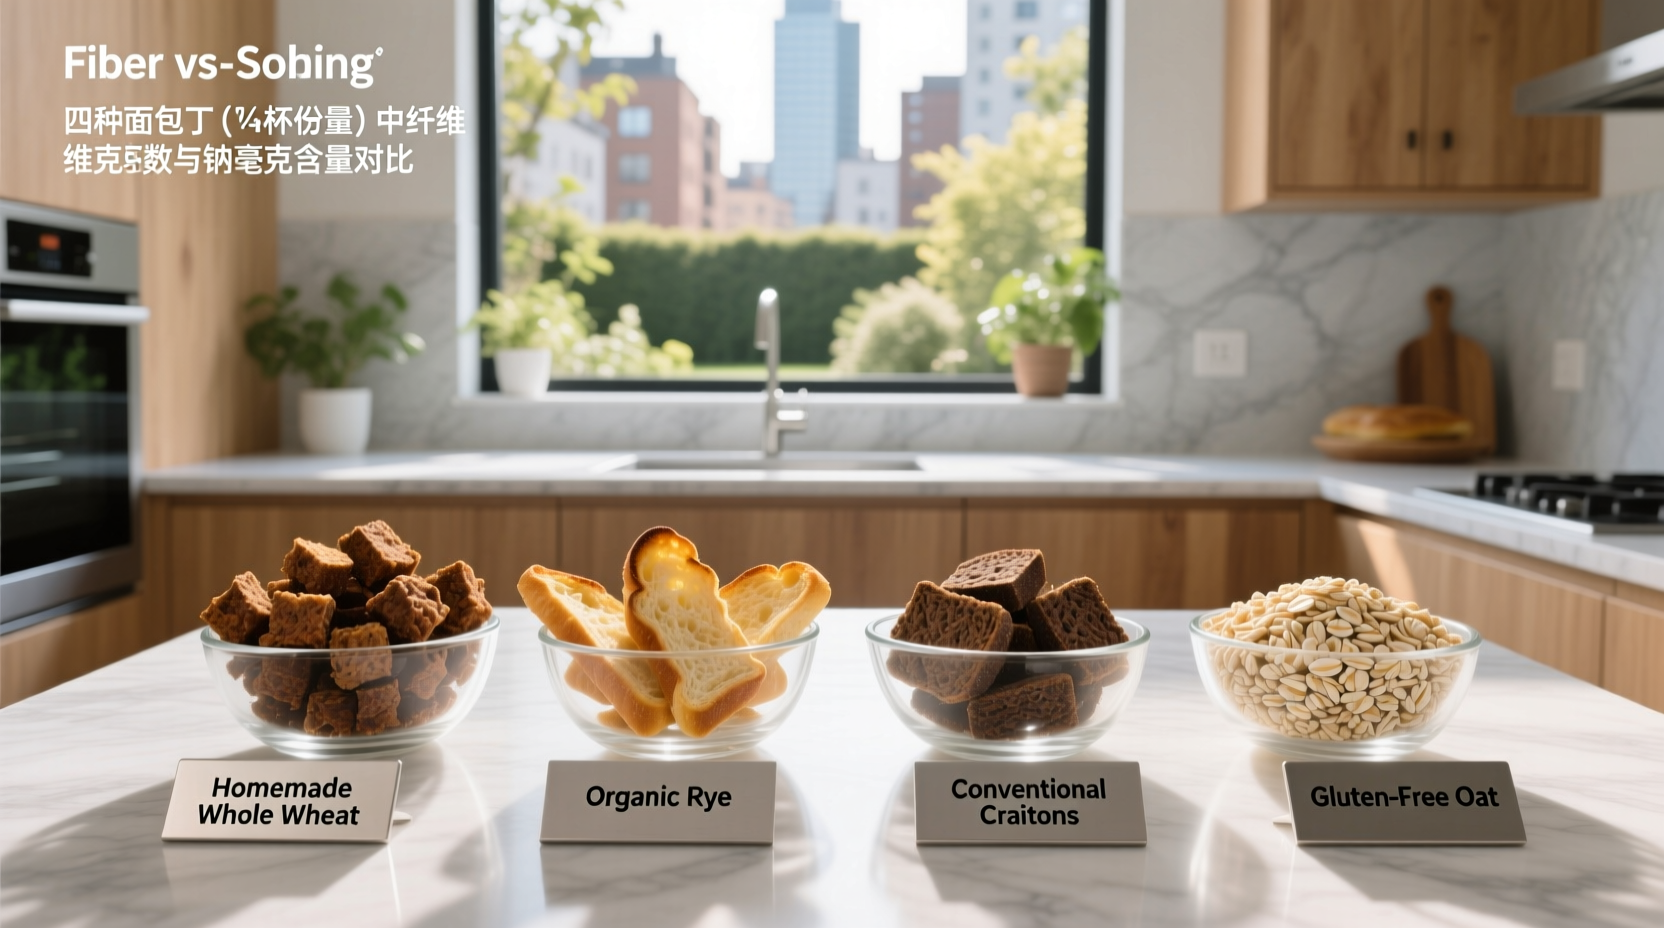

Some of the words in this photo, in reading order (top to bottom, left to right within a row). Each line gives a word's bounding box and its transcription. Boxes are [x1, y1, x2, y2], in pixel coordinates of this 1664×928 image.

[211, 776, 353, 798] Homemade
[585, 784, 680, 813] Organic
[687, 785, 733, 811] Rye
[950, 777, 1108, 800] Conventional
[1310, 784, 1451, 808] Gluten-Free
[1454, 785, 1501, 808] Oat
[197, 802, 274, 826] Whole
[281, 802, 361, 826] Wheat
[980, 803, 1081, 826] Craitons
